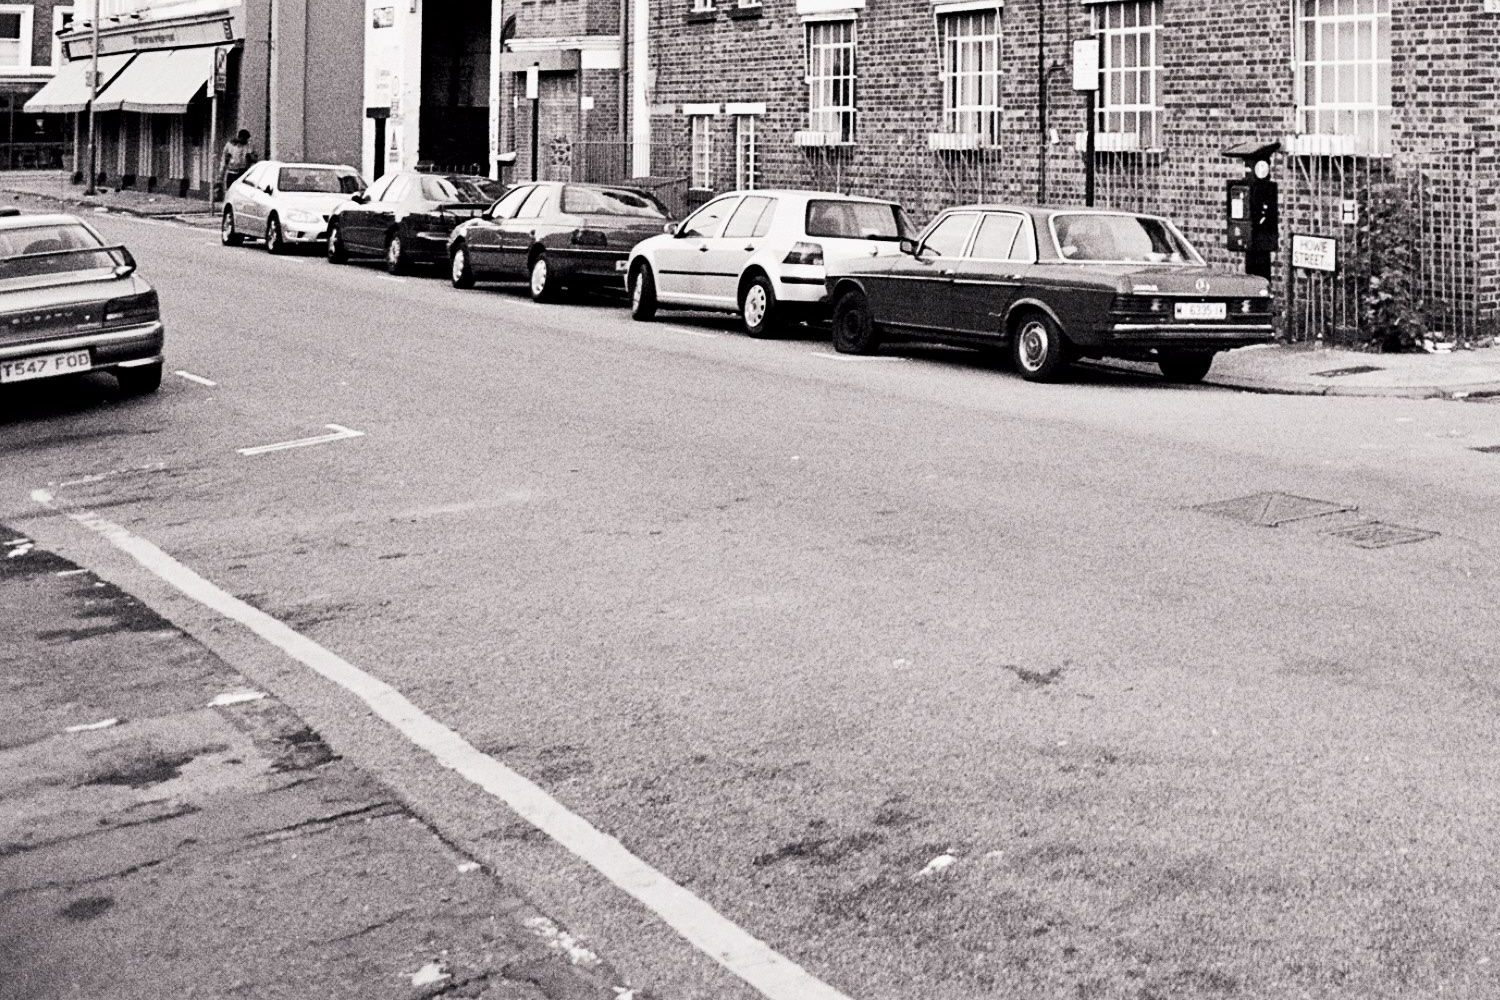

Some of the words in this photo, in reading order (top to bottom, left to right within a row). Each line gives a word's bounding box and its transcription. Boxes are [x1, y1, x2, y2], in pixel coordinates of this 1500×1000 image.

[1294, 250, 1325, 266] STREET
[2, 360, 48, 377] T547
[55, 353, 89, 370] FOD
